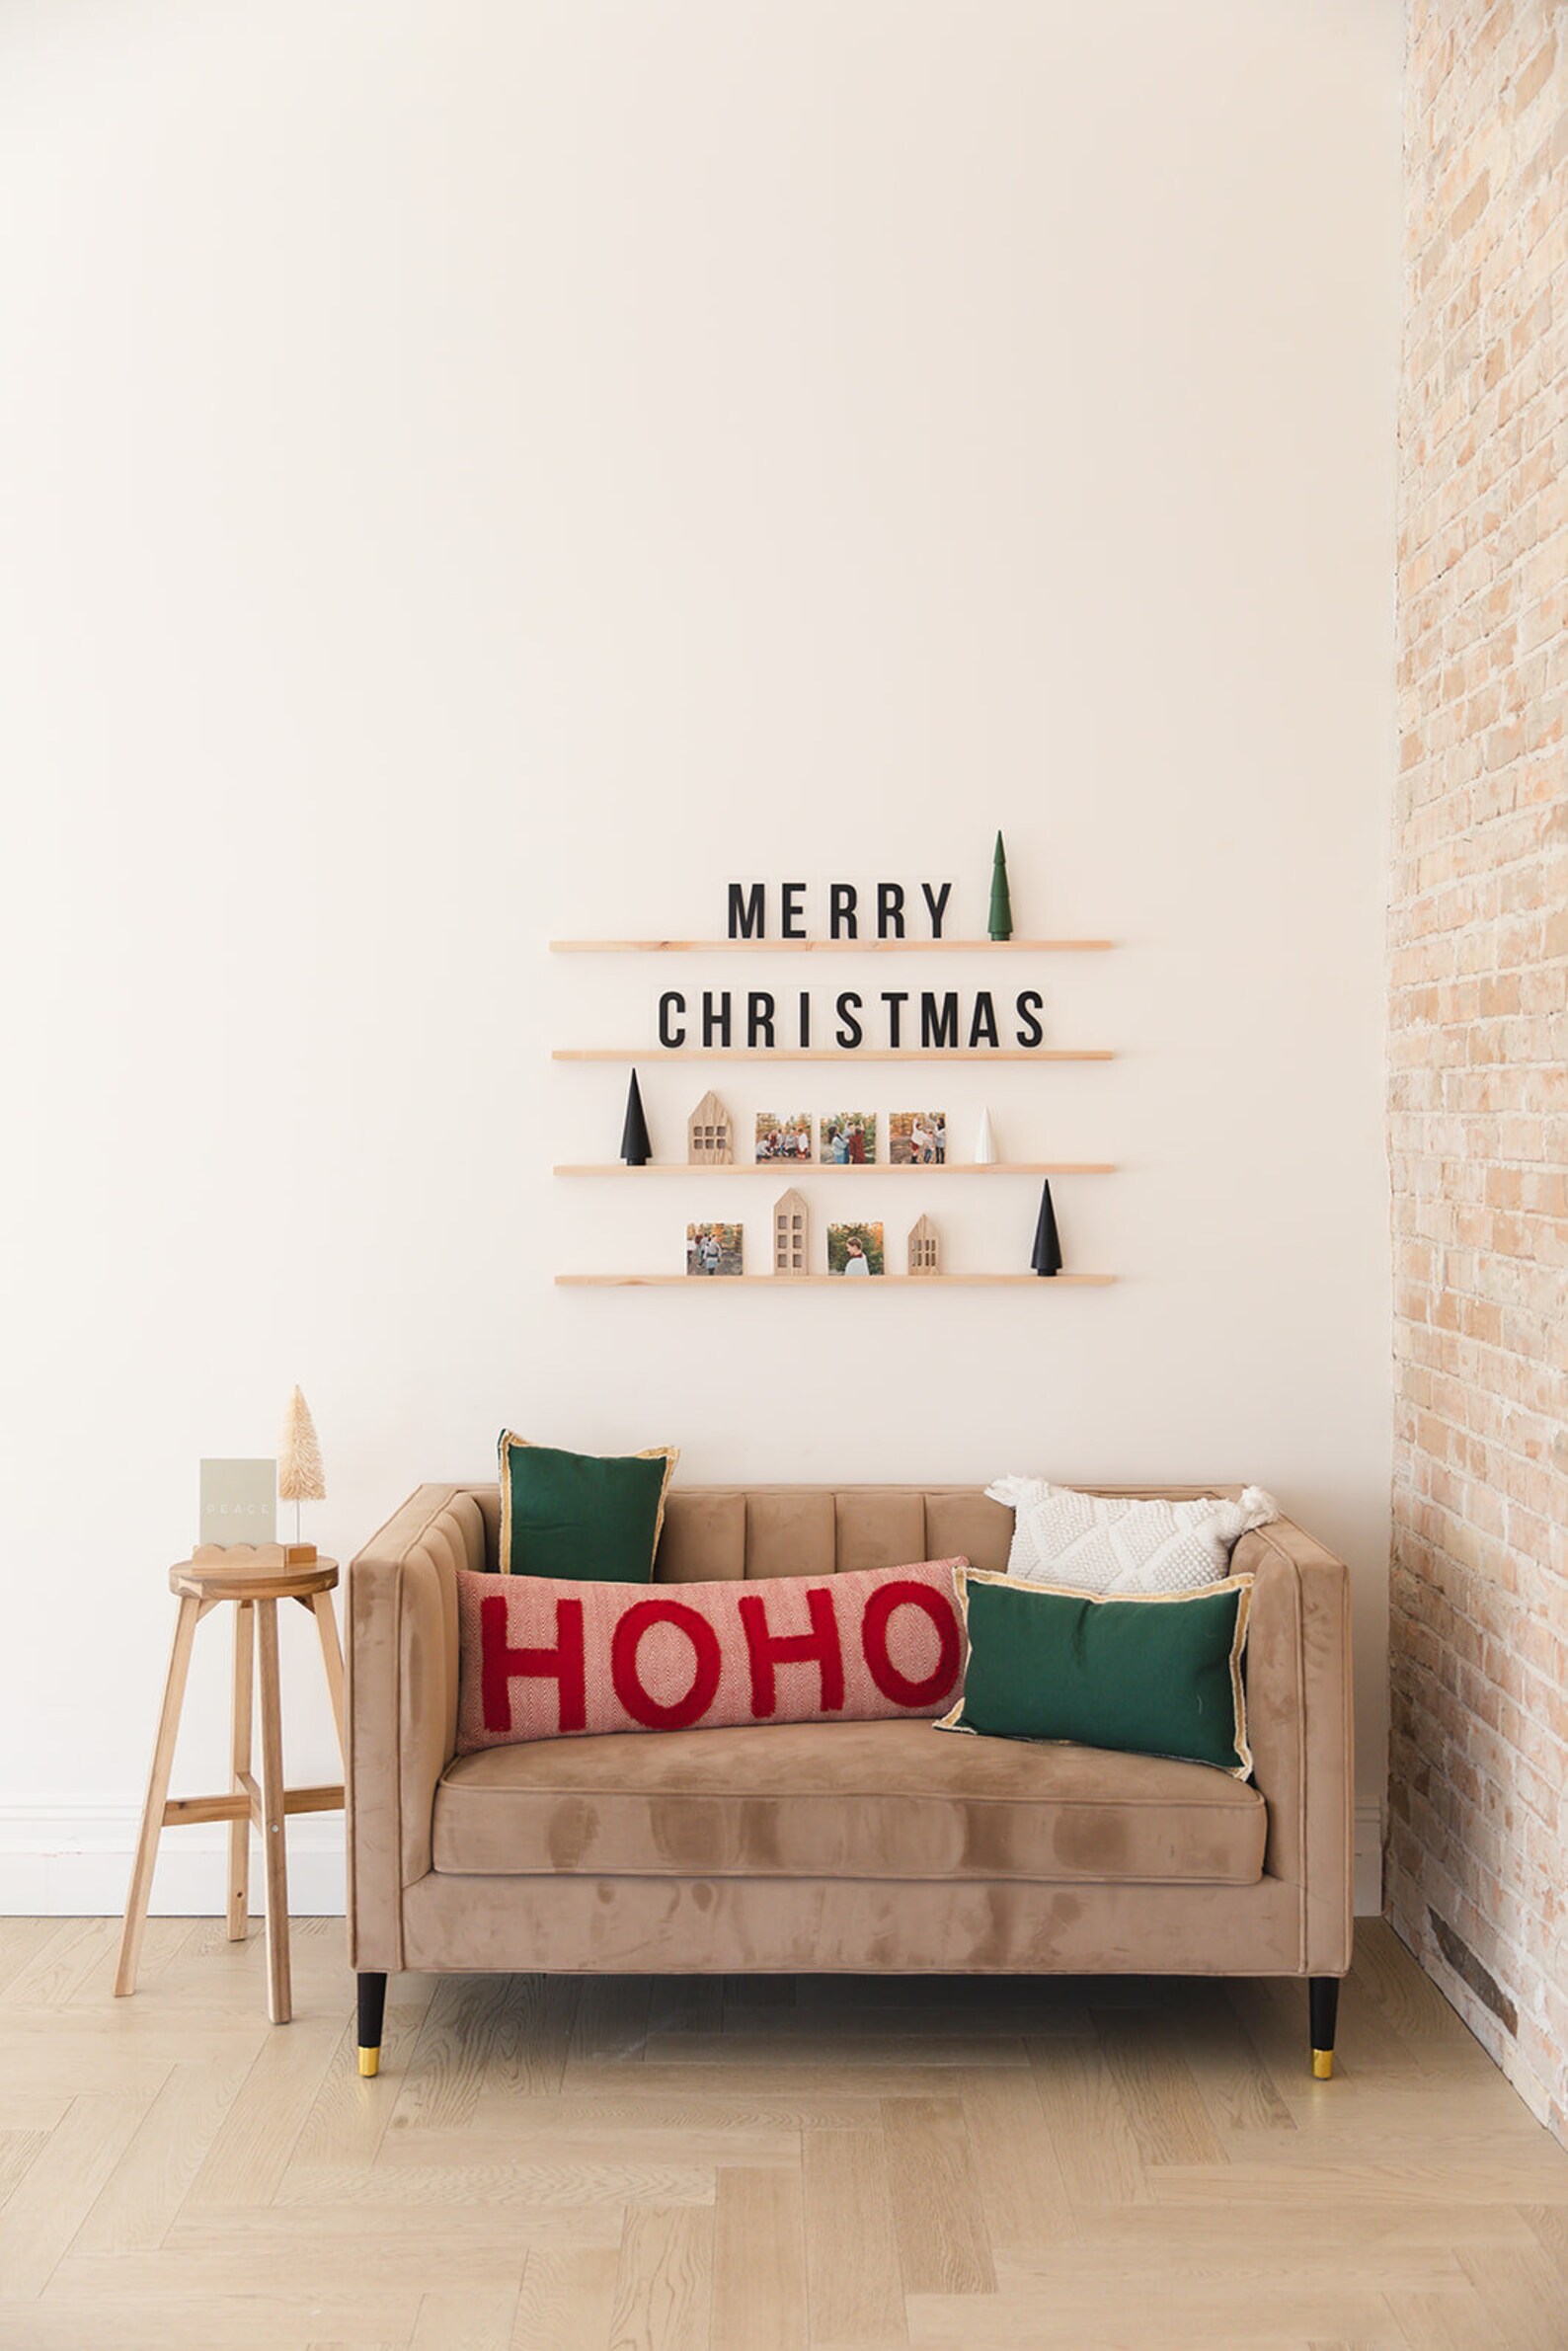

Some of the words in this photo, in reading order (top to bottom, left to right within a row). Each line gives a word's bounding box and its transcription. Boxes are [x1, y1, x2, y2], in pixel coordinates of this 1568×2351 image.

[728, 883, 953, 940] MERRY
[659, 990, 1045, 1050] CHRISTMAS
[206, 1504, 270, 1516] PEACE
[481, 1581, 962, 1732] HOHO
